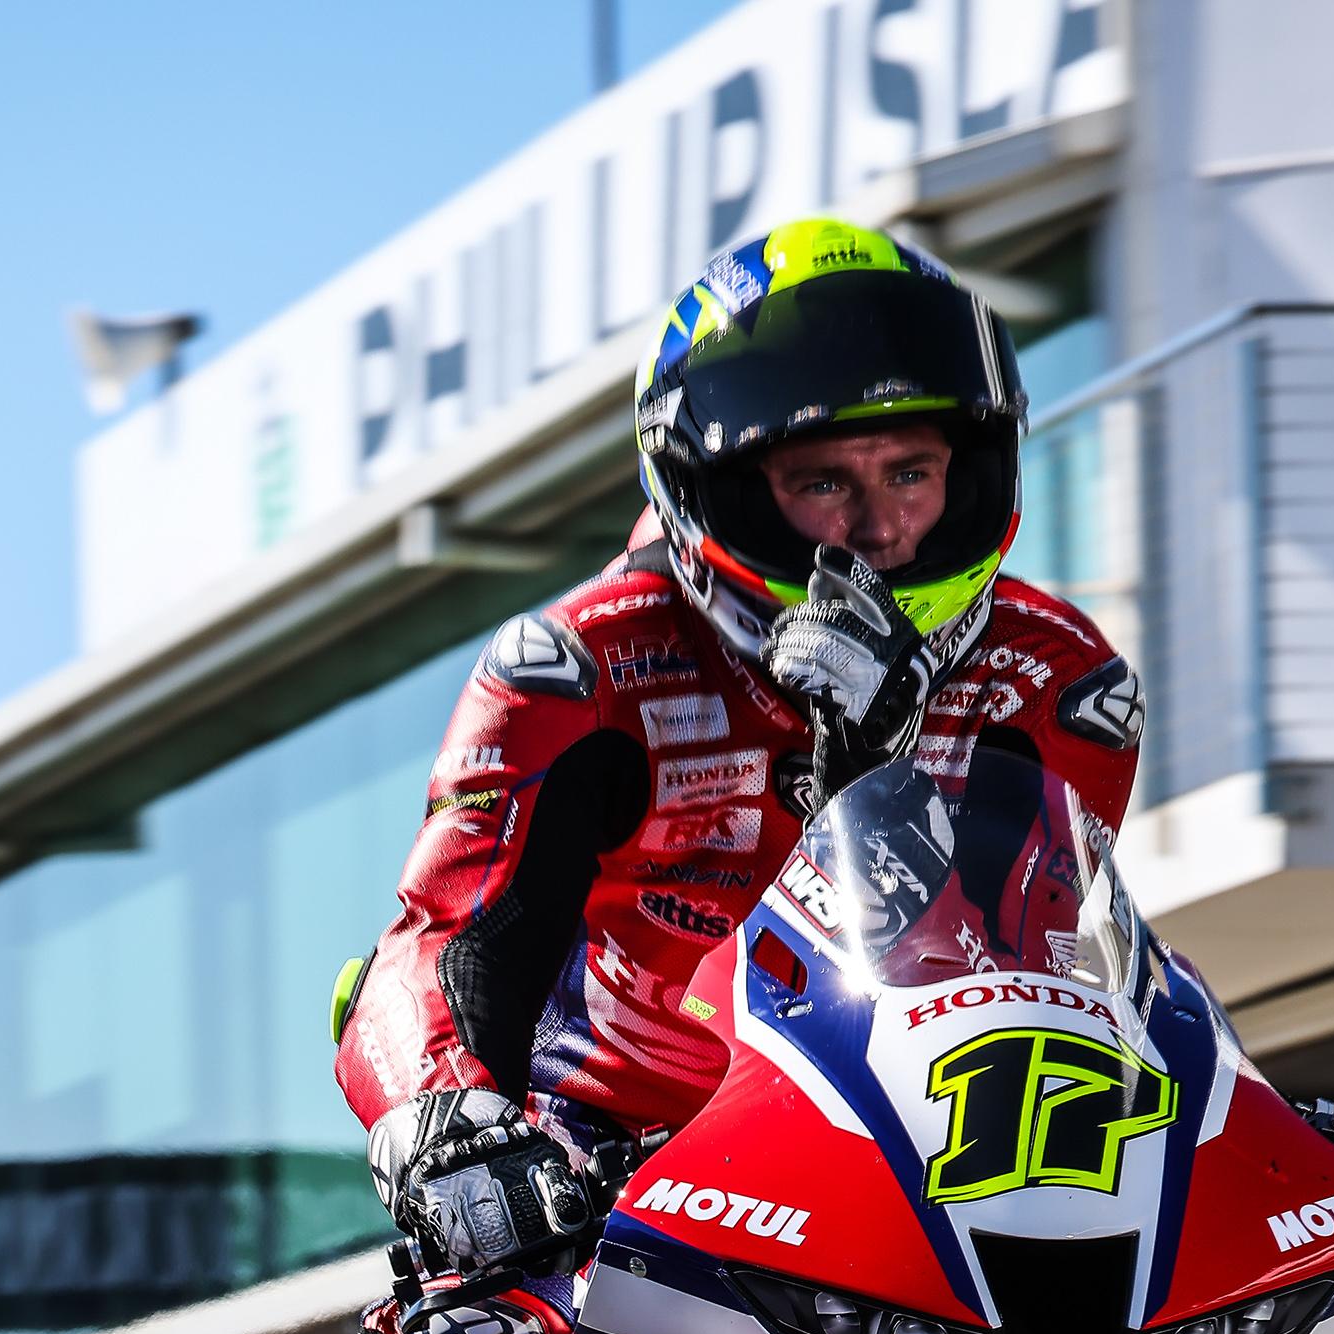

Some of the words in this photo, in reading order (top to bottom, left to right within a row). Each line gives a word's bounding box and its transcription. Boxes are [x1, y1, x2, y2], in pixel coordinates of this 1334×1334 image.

[667, 763, 757, 786] HONDA
[905, 984, 1122, 1033] HONDA
[921, 1027, 1179, 1205] 17
[633, 1177, 813, 1247] MOTUL
